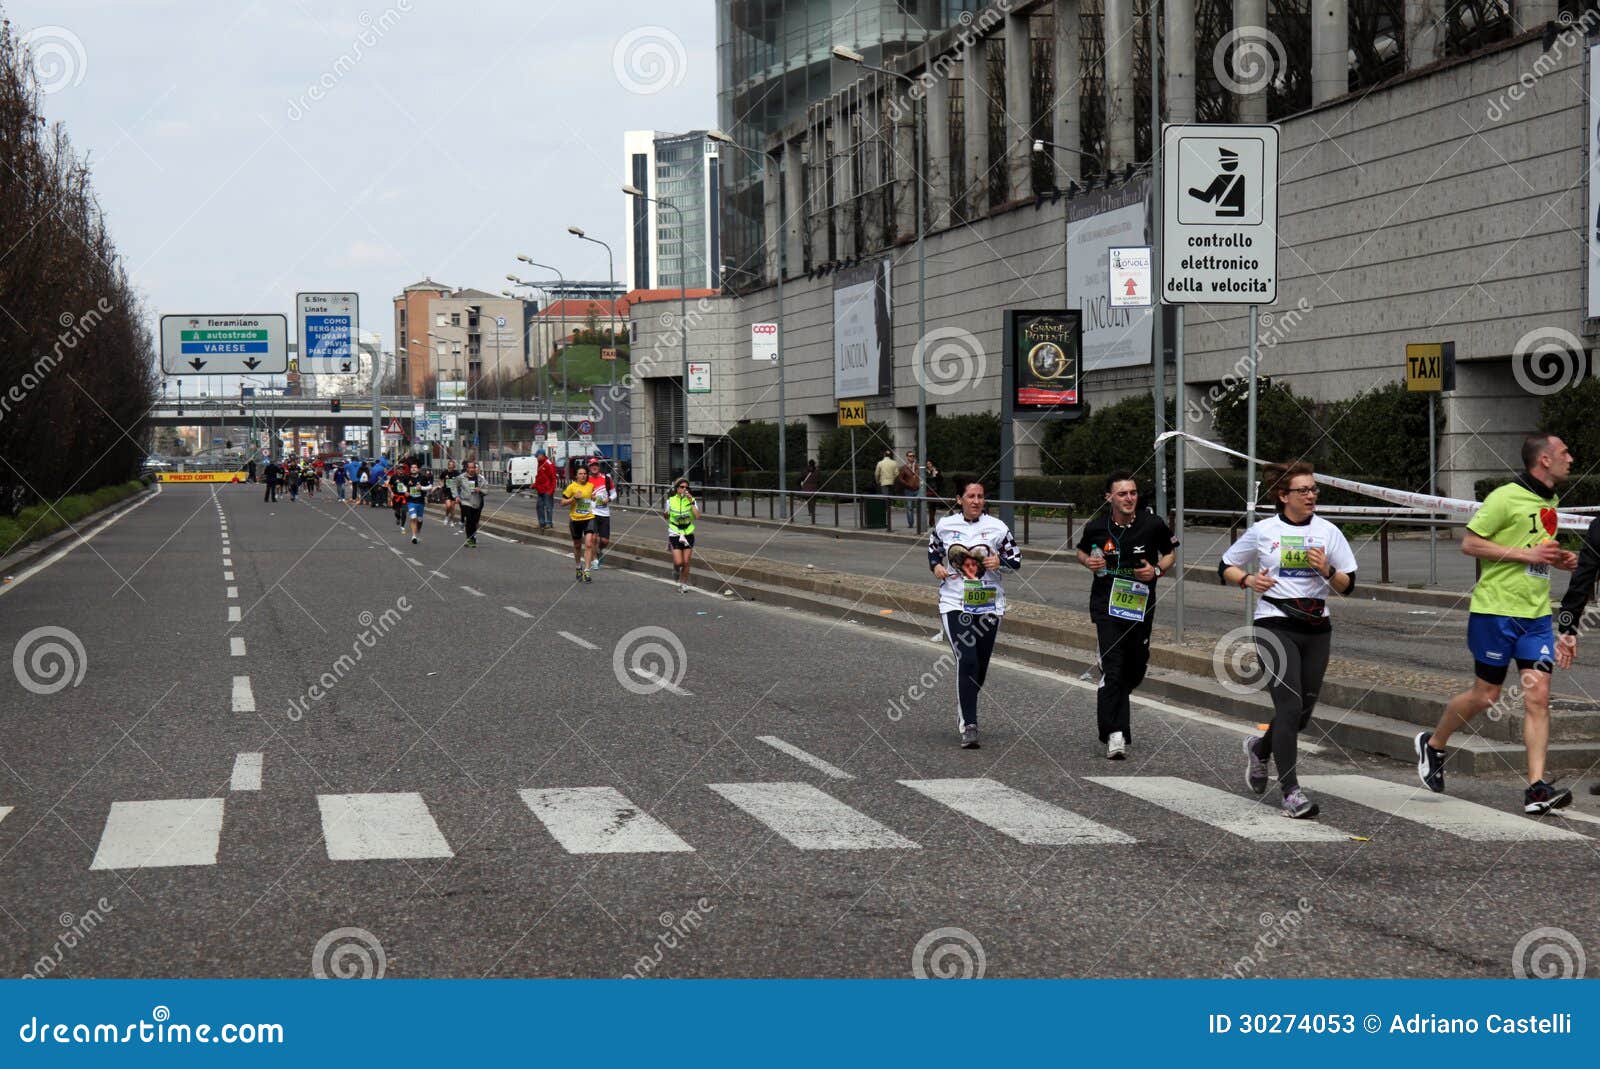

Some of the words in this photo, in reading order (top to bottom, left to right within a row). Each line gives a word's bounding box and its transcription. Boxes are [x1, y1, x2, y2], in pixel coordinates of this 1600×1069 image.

[1187, 233, 1253, 248] controllo
[1180, 255, 1259, 270] elettronico
[1167, 277, 1203, 292] della
[207, 319, 259, 327] fieramilano
[206, 331, 258, 340] autostrade
[753, 325, 777, 335] coop
[203, 344, 247, 353] VARESE
[1409, 356, 1440, 379] TAXI
[840, 407, 864, 419] TAXI
[1528, 513, 1539, 534] I
[1115, 592, 1134, 605] 702
